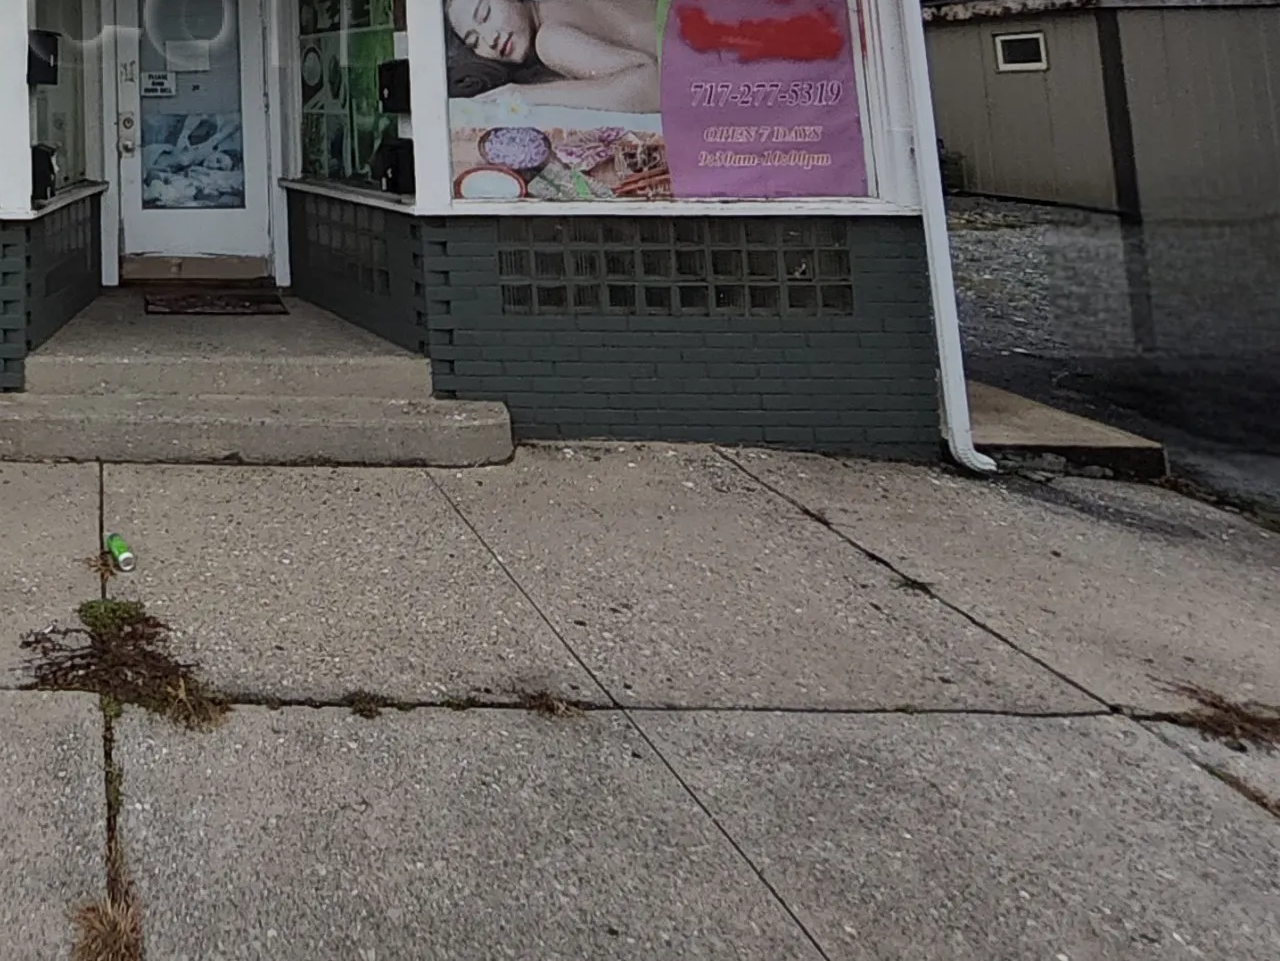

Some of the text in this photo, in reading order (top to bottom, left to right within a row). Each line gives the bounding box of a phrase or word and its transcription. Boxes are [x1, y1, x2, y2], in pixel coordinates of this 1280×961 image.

[690, 80, 843, 107] 717-277-5319
[703, 125, 823, 142] OPEN 7 DAYS
[698, 149, 832, 170] 9:30am-10:00pm
